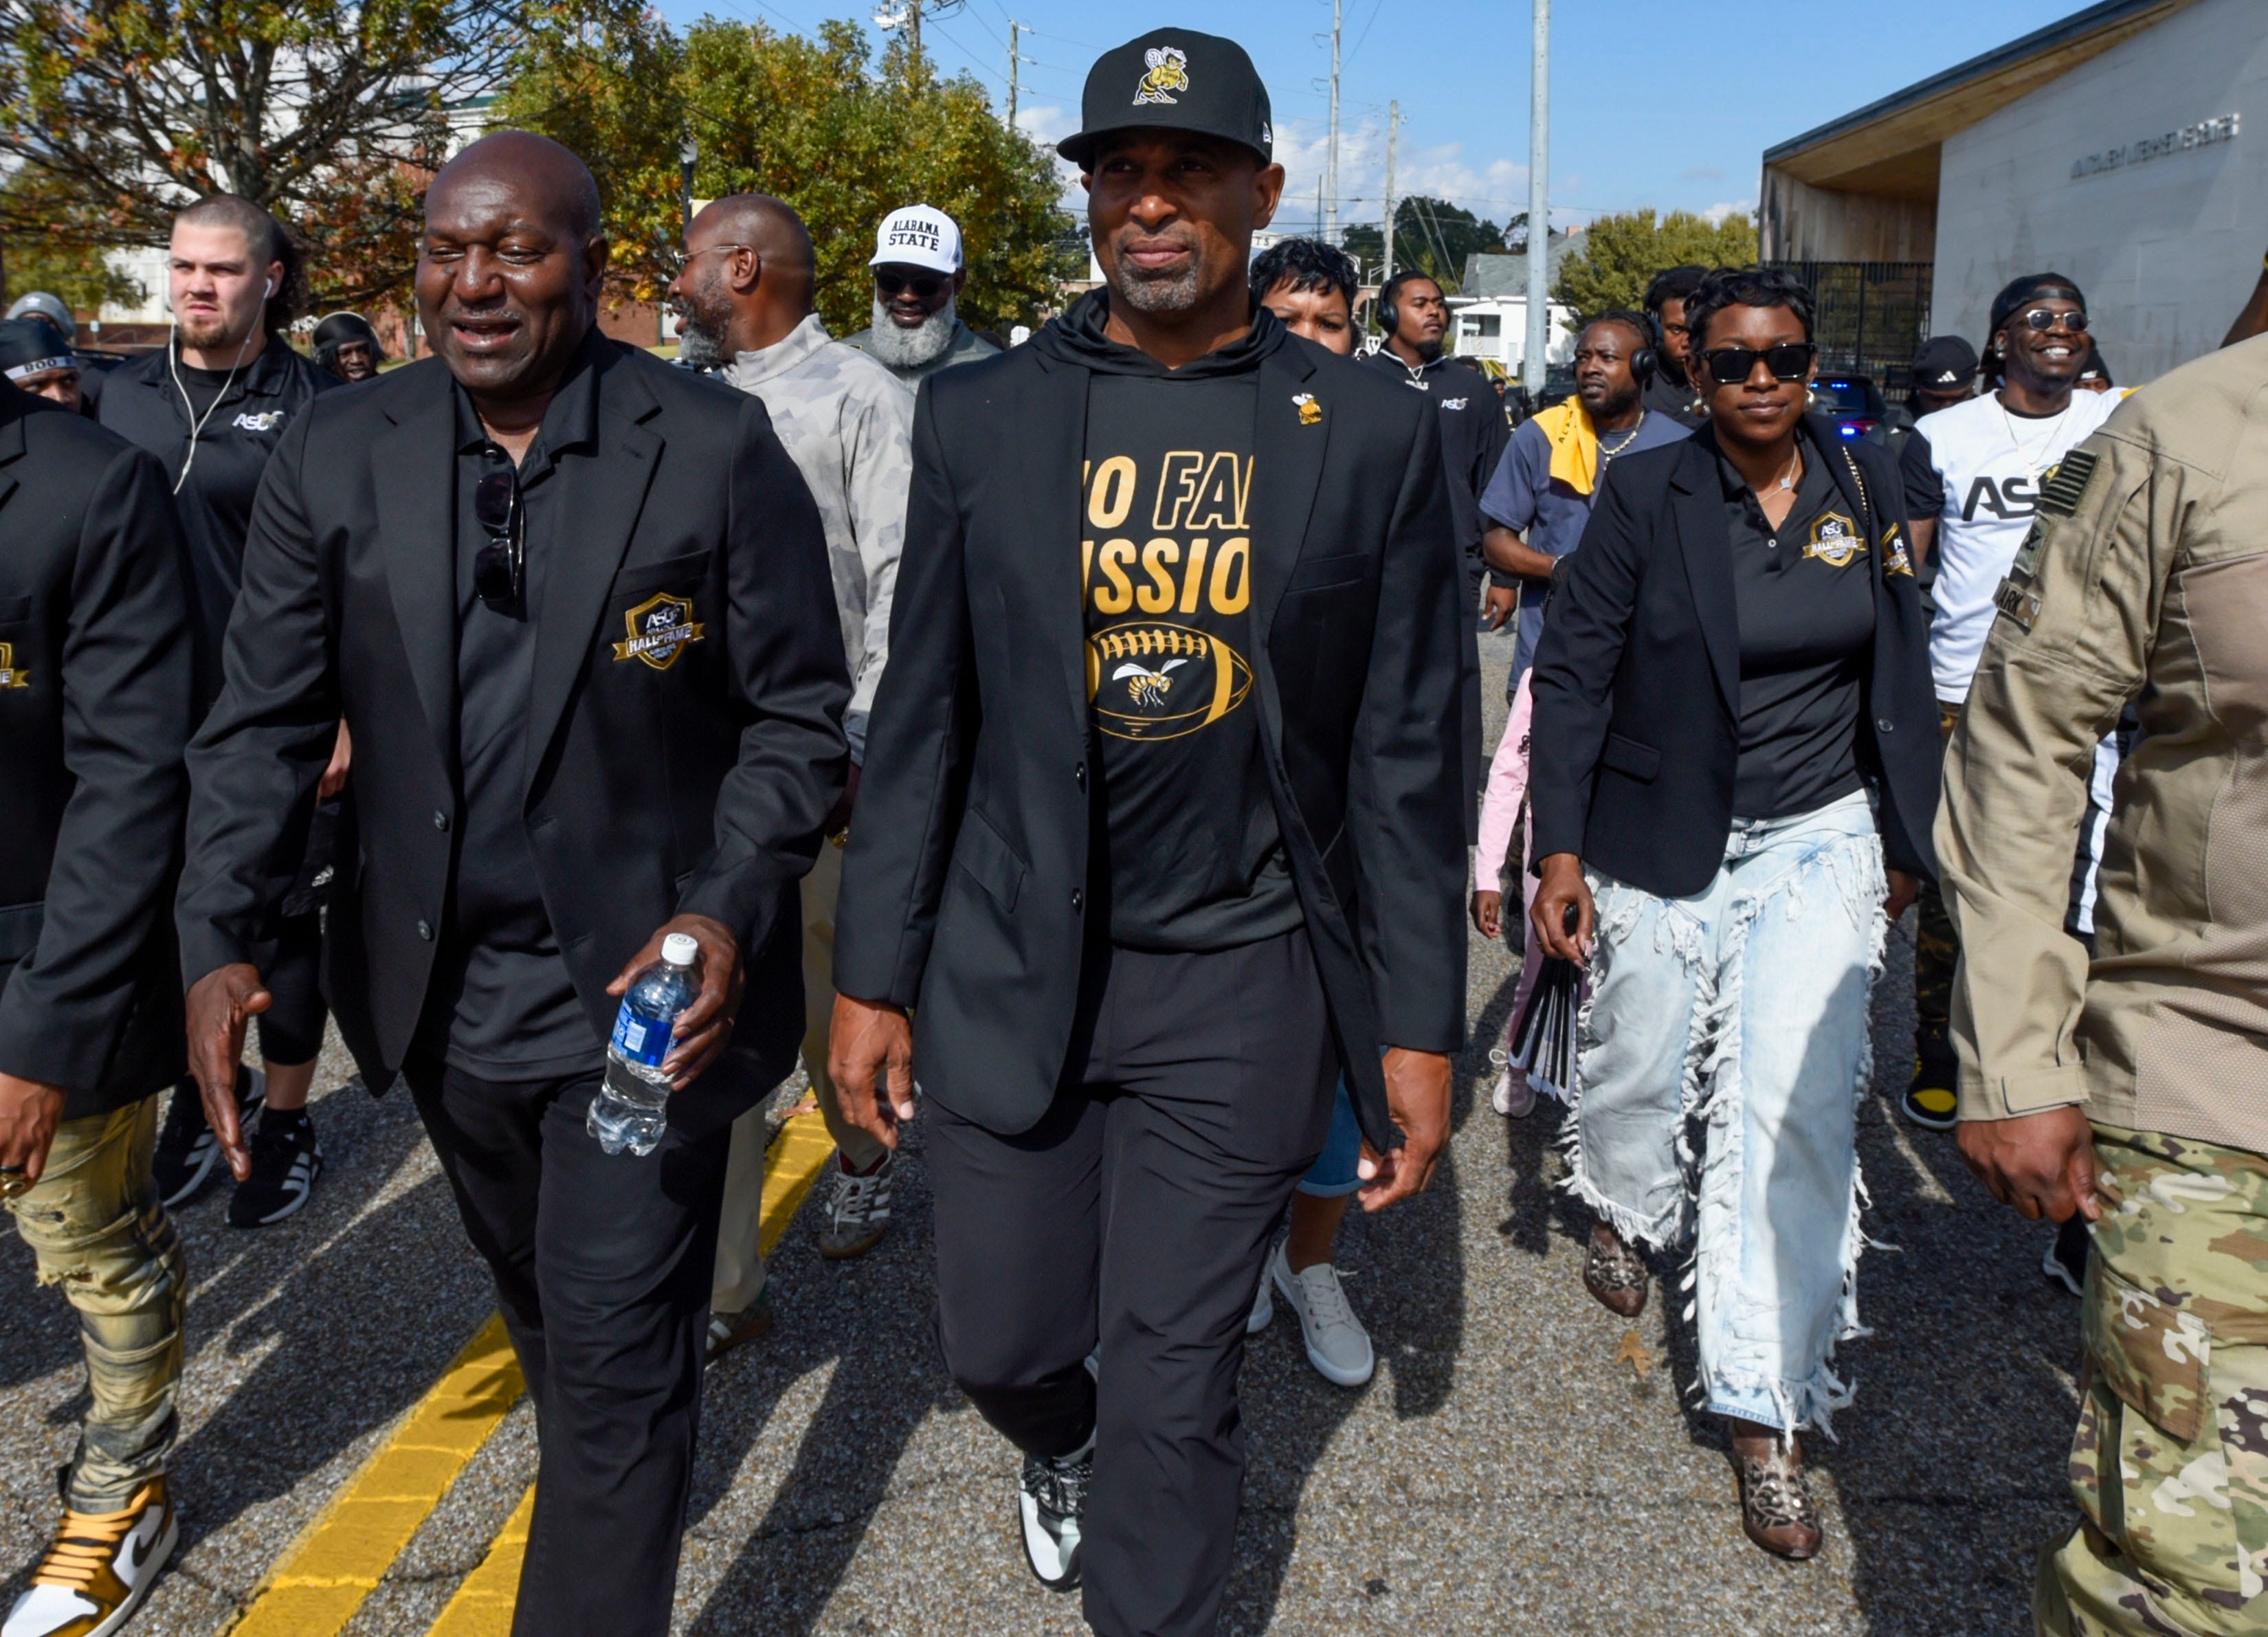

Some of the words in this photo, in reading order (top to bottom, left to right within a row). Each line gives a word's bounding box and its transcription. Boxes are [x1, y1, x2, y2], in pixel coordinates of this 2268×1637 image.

[889, 232, 940, 252] STATE
[891, 219, 940, 237] ALABAMA
[1083, 455, 1137, 529] O
[1152, 450, 1254, 531] FA
[1962, 475, 2048, 522] AS
[628, 635, 658, 654] HALL
[664, 625, 691, 644] FAME
